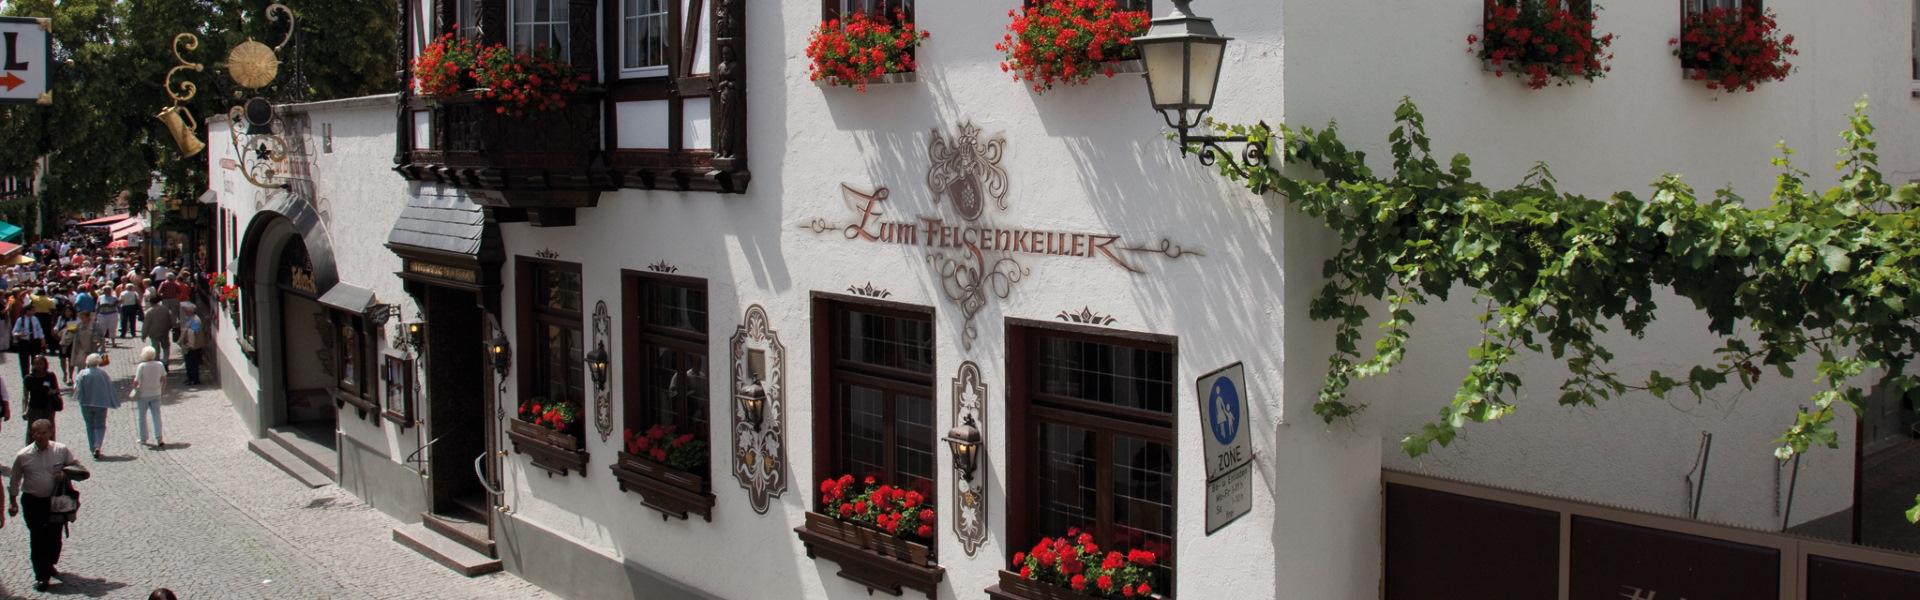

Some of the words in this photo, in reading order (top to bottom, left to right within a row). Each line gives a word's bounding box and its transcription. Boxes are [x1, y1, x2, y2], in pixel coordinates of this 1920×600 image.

[3, 31, 29, 71] L
[840, 181, 919, 246] Zum
[1218, 446, 1241, 470] ZONE
